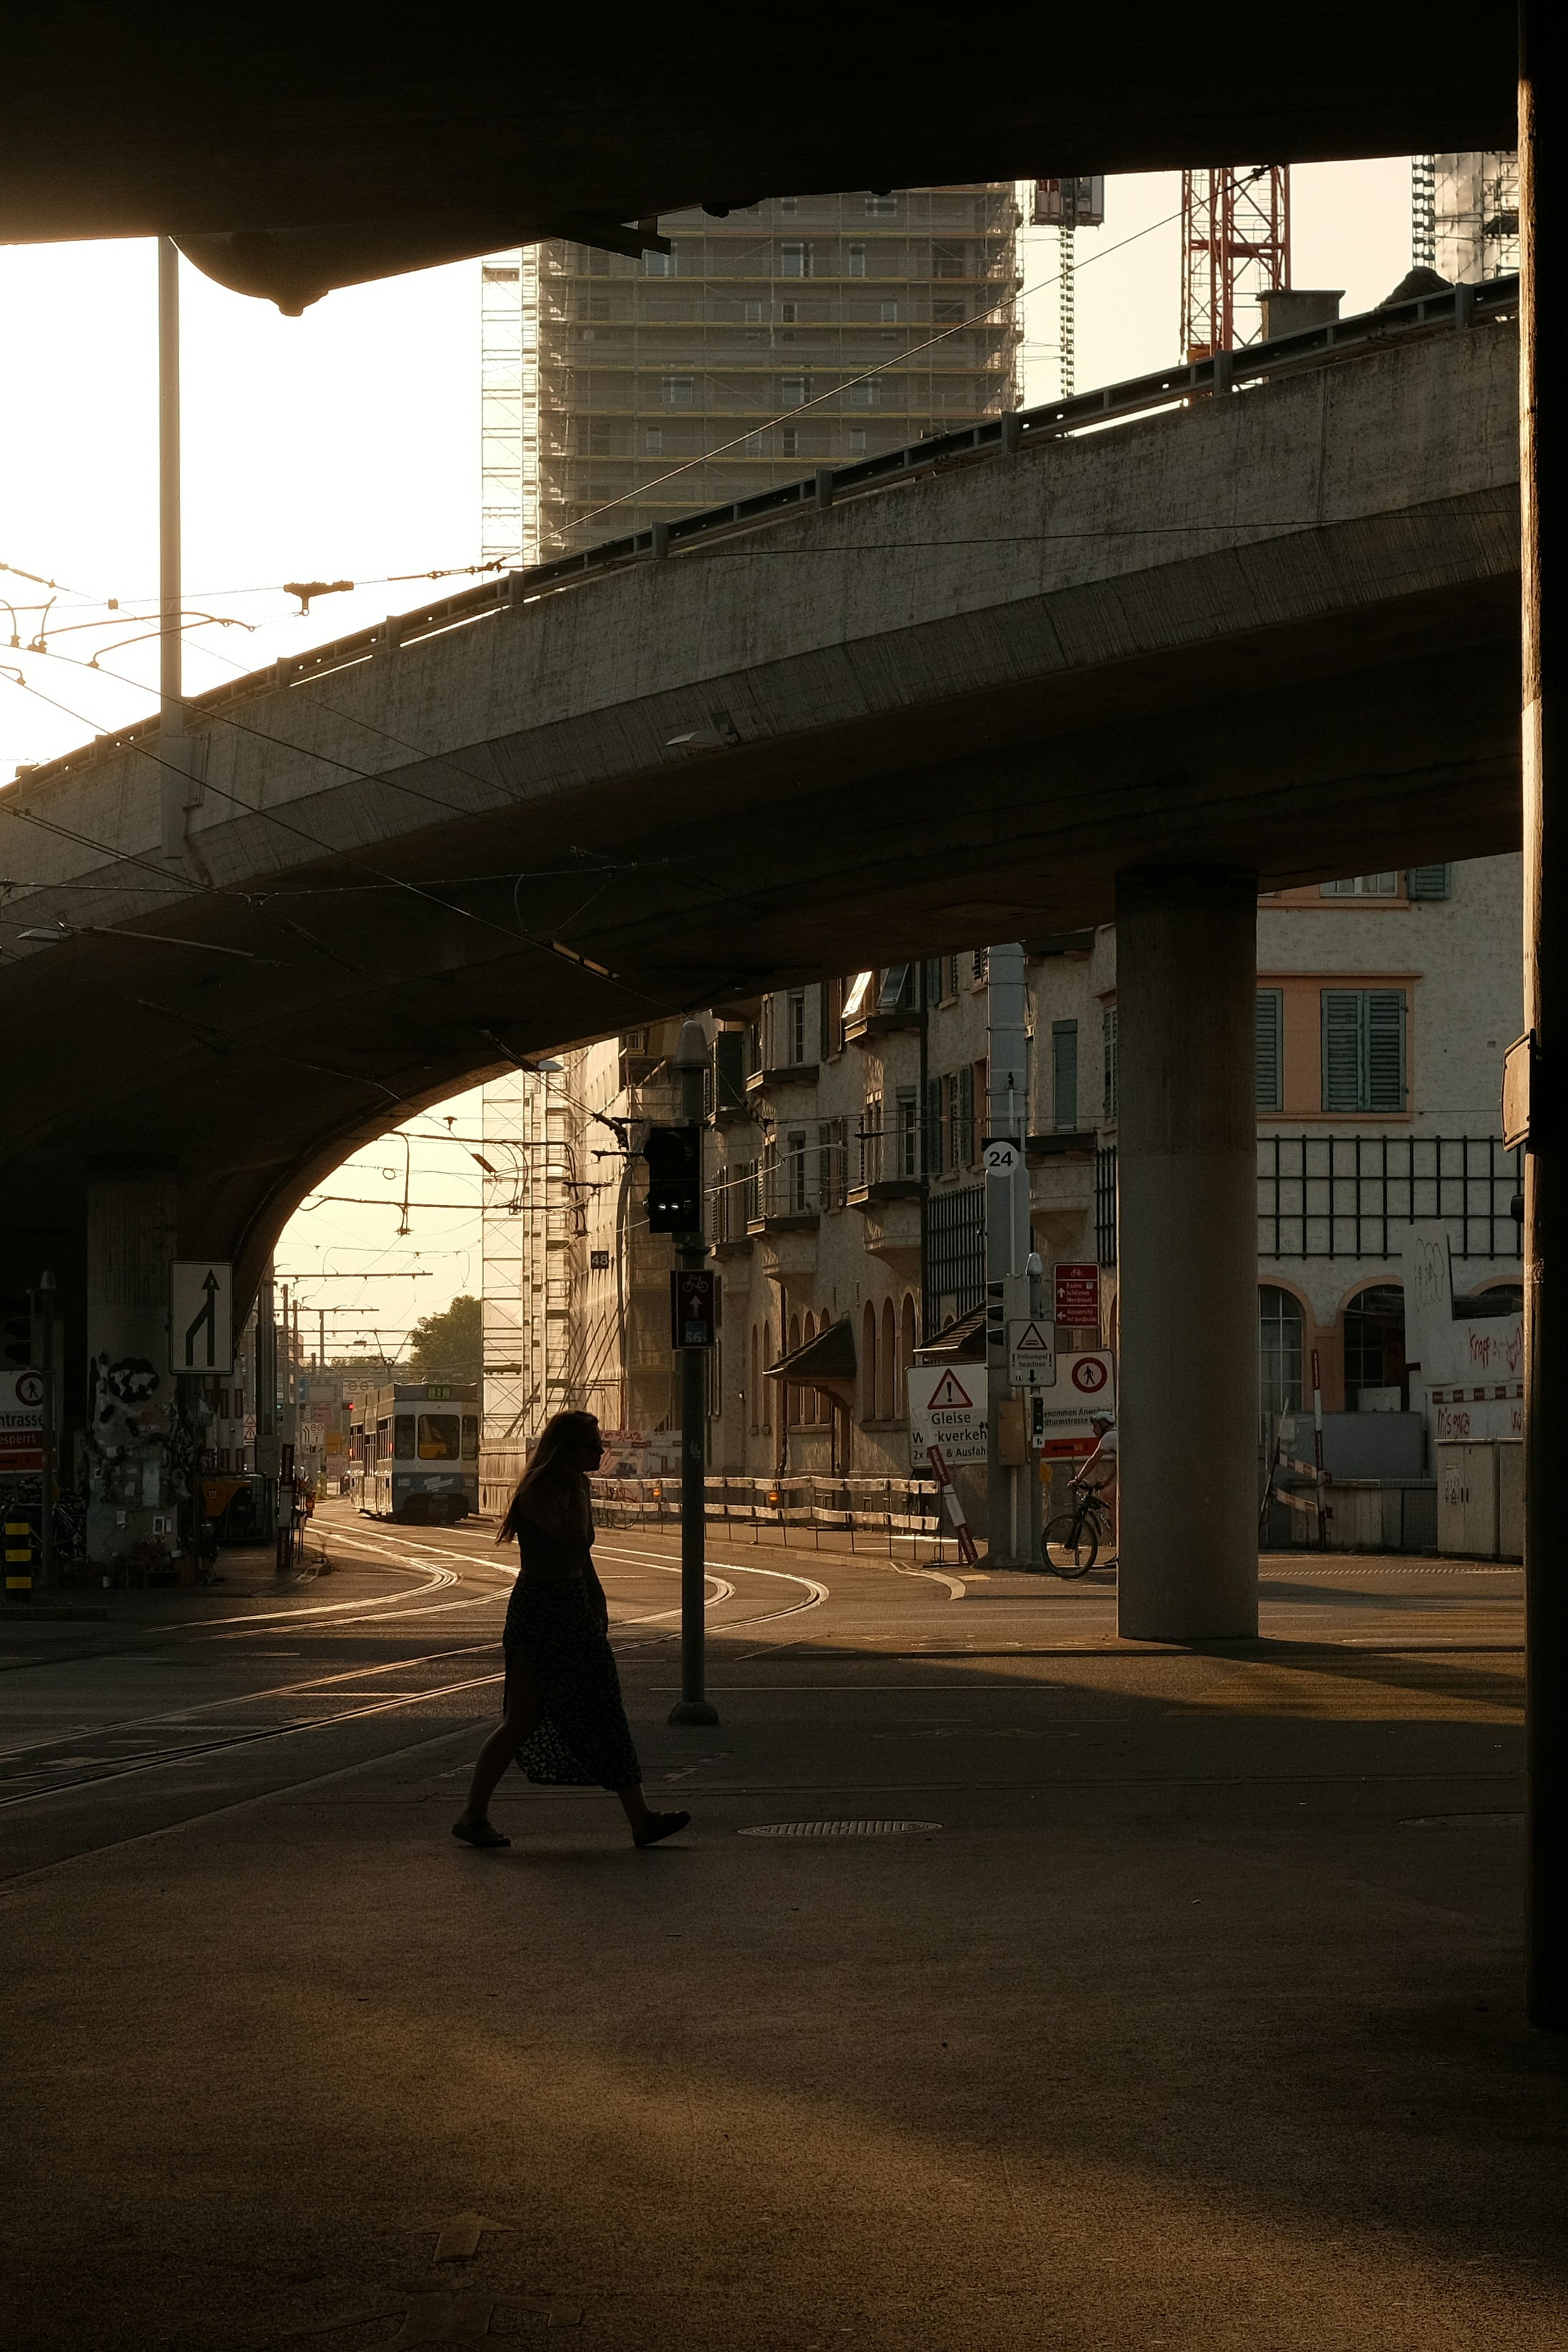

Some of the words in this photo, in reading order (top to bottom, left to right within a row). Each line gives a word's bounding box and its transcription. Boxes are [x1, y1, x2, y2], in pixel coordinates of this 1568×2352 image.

[989, 1151, 1013, 1166] 24
[931, 1411, 971, 1425] Gleise
[1043, 1409, 1077, 1418] enommen
[912, 1427, 988, 1444] Wkverkeh
[913, 1450, 924, 1460] 2x
[946, 1448, 953, 1458] &
[955, 1445, 989, 1457] Ausfah
